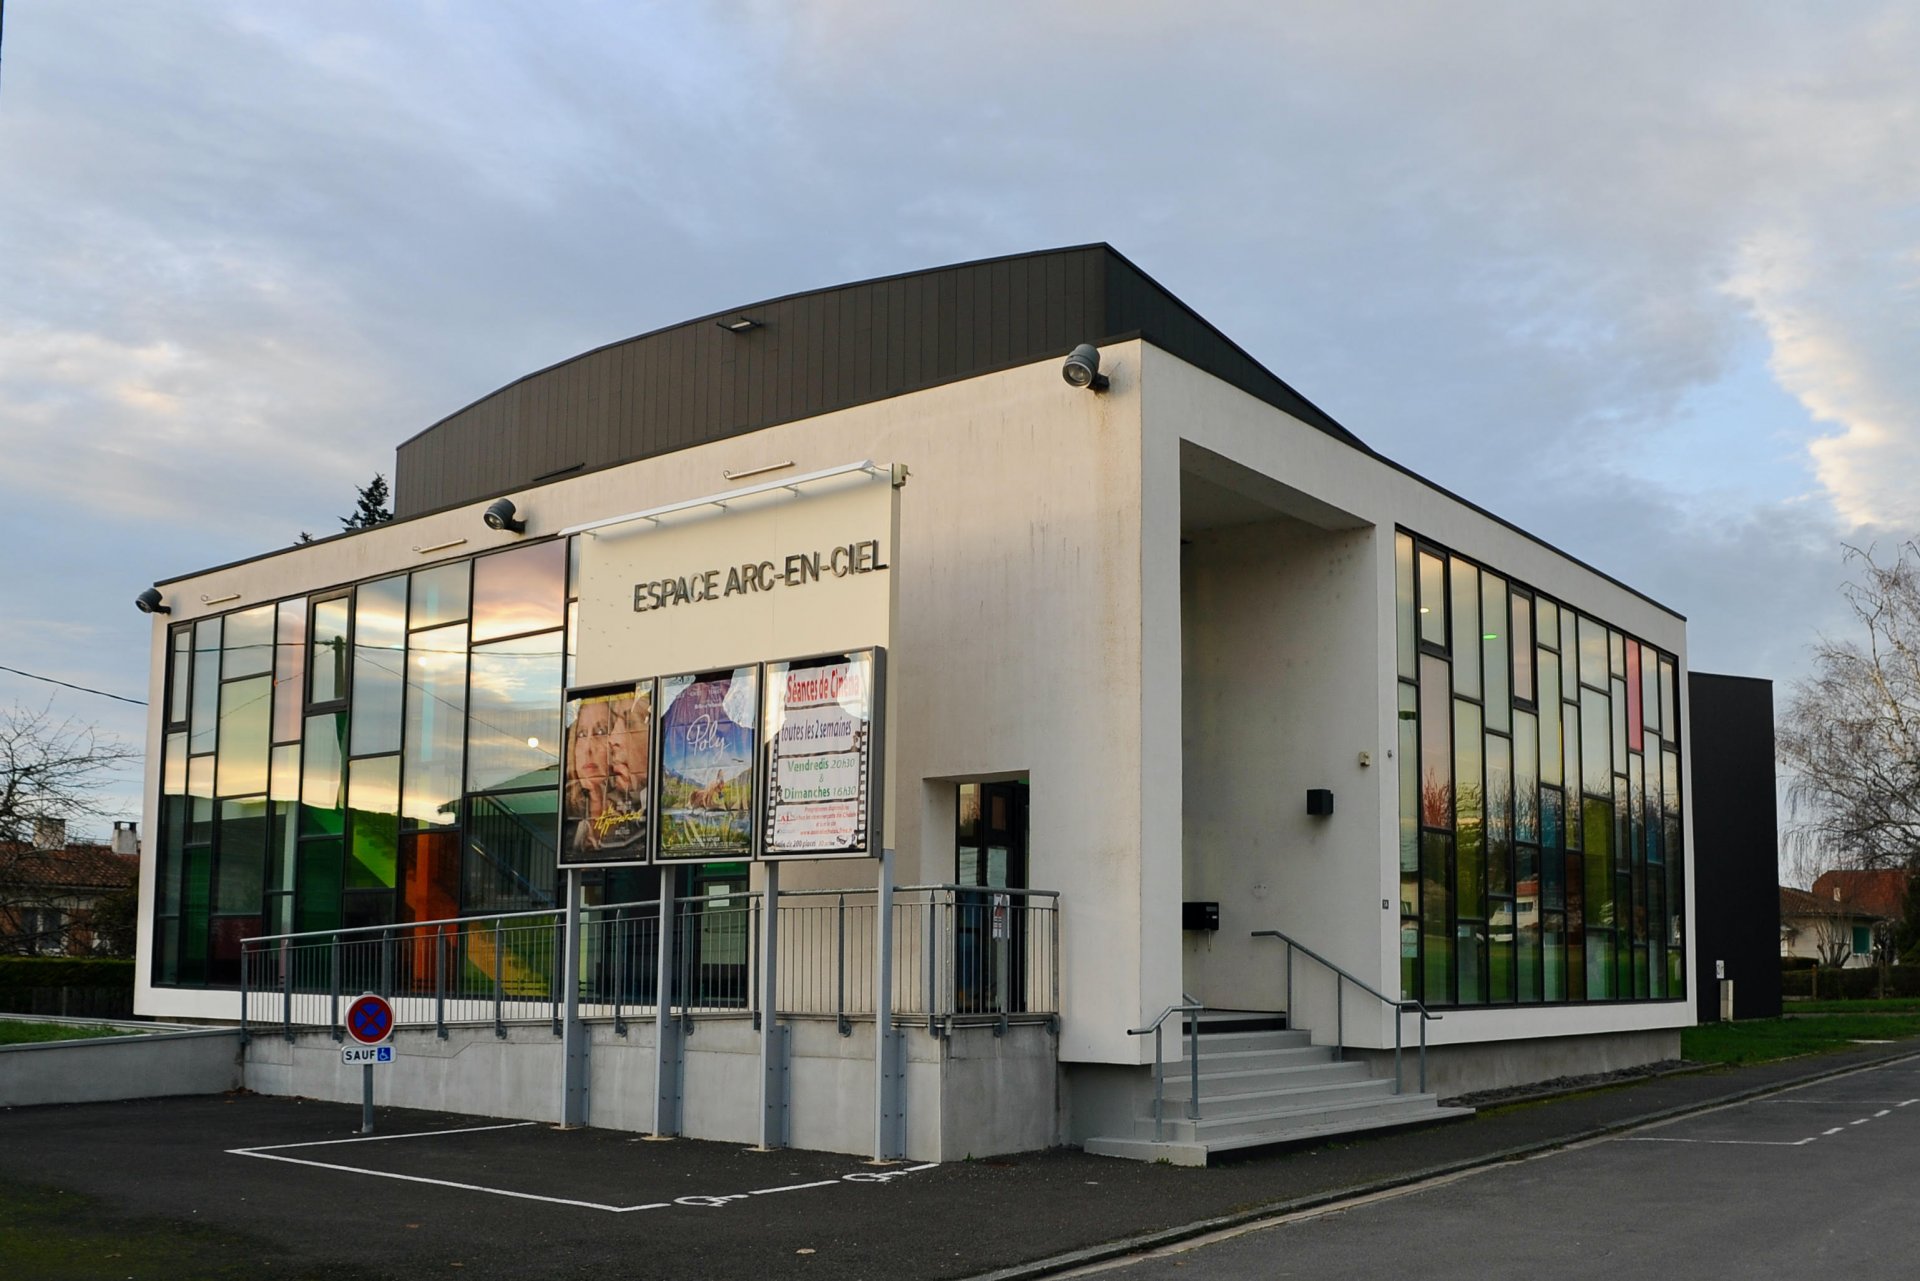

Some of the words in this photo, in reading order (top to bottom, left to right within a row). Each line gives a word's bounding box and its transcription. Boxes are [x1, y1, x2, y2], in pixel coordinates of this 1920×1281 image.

[633, 570, 721, 612] ESPACE
[723, 539, 890, 597] ARC-EN-CIEL
[786, 673, 818, 703] Séances
[819, 669, 829, 699] de
[686, 713, 733, 763] Poly
[781, 723, 804, 742] toutes
[804, 719, 815, 740] les
[788, 758, 829, 773] Vendredis
[830, 758, 856, 770] 20h30
[784, 785, 831, 800] Dimanches
[832, 785, 857, 797] 16h30
[345, 1050, 376, 1061] SAUF
